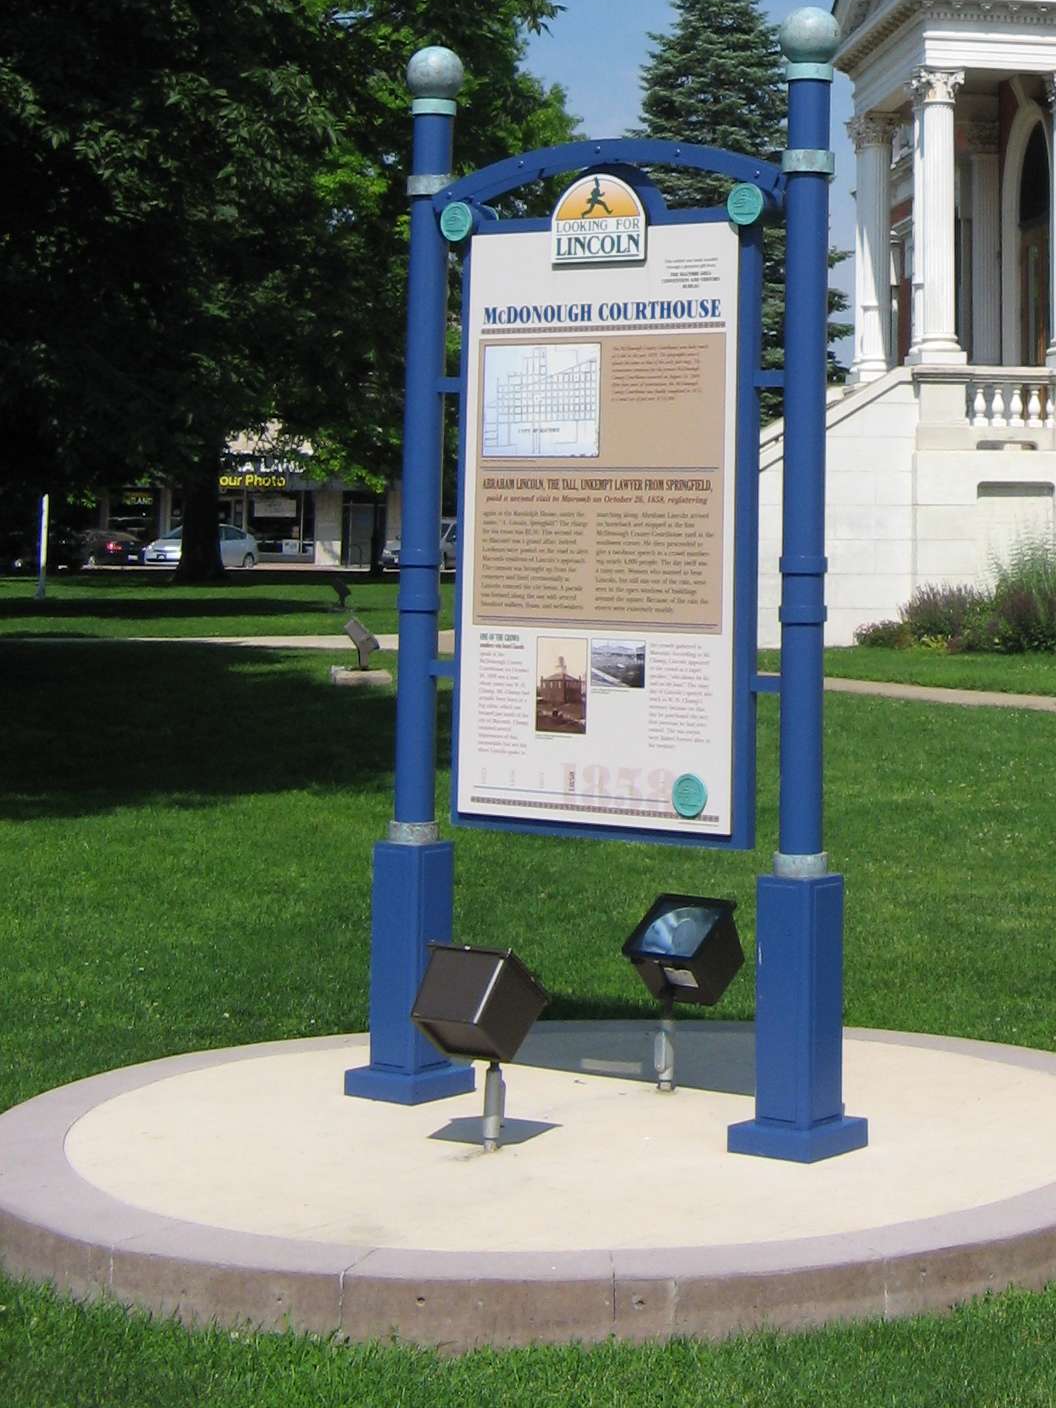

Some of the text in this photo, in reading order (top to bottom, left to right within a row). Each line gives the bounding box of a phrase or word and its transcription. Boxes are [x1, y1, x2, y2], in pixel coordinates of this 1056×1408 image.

[556, 218, 639, 233] LOOKING FOR
[556, 234, 640, 256] LINCOLN
[483, 299, 721, 325] McDONOUGH COURTHOUSE
[219, 474, 286, 487] our Photo
[482, 479, 515, 490] ABRAHAM
[547, 479, 560, 490] THE
[615, 479, 642, 490] LAWYER
[644, 479, 664, 490] FROM
[666, 479, 713, 492] SPRINGFIELD,
[536, 495, 551, 503] visit
[604, 495, 632, 504] October
[667, 496, 708, 506] registering
